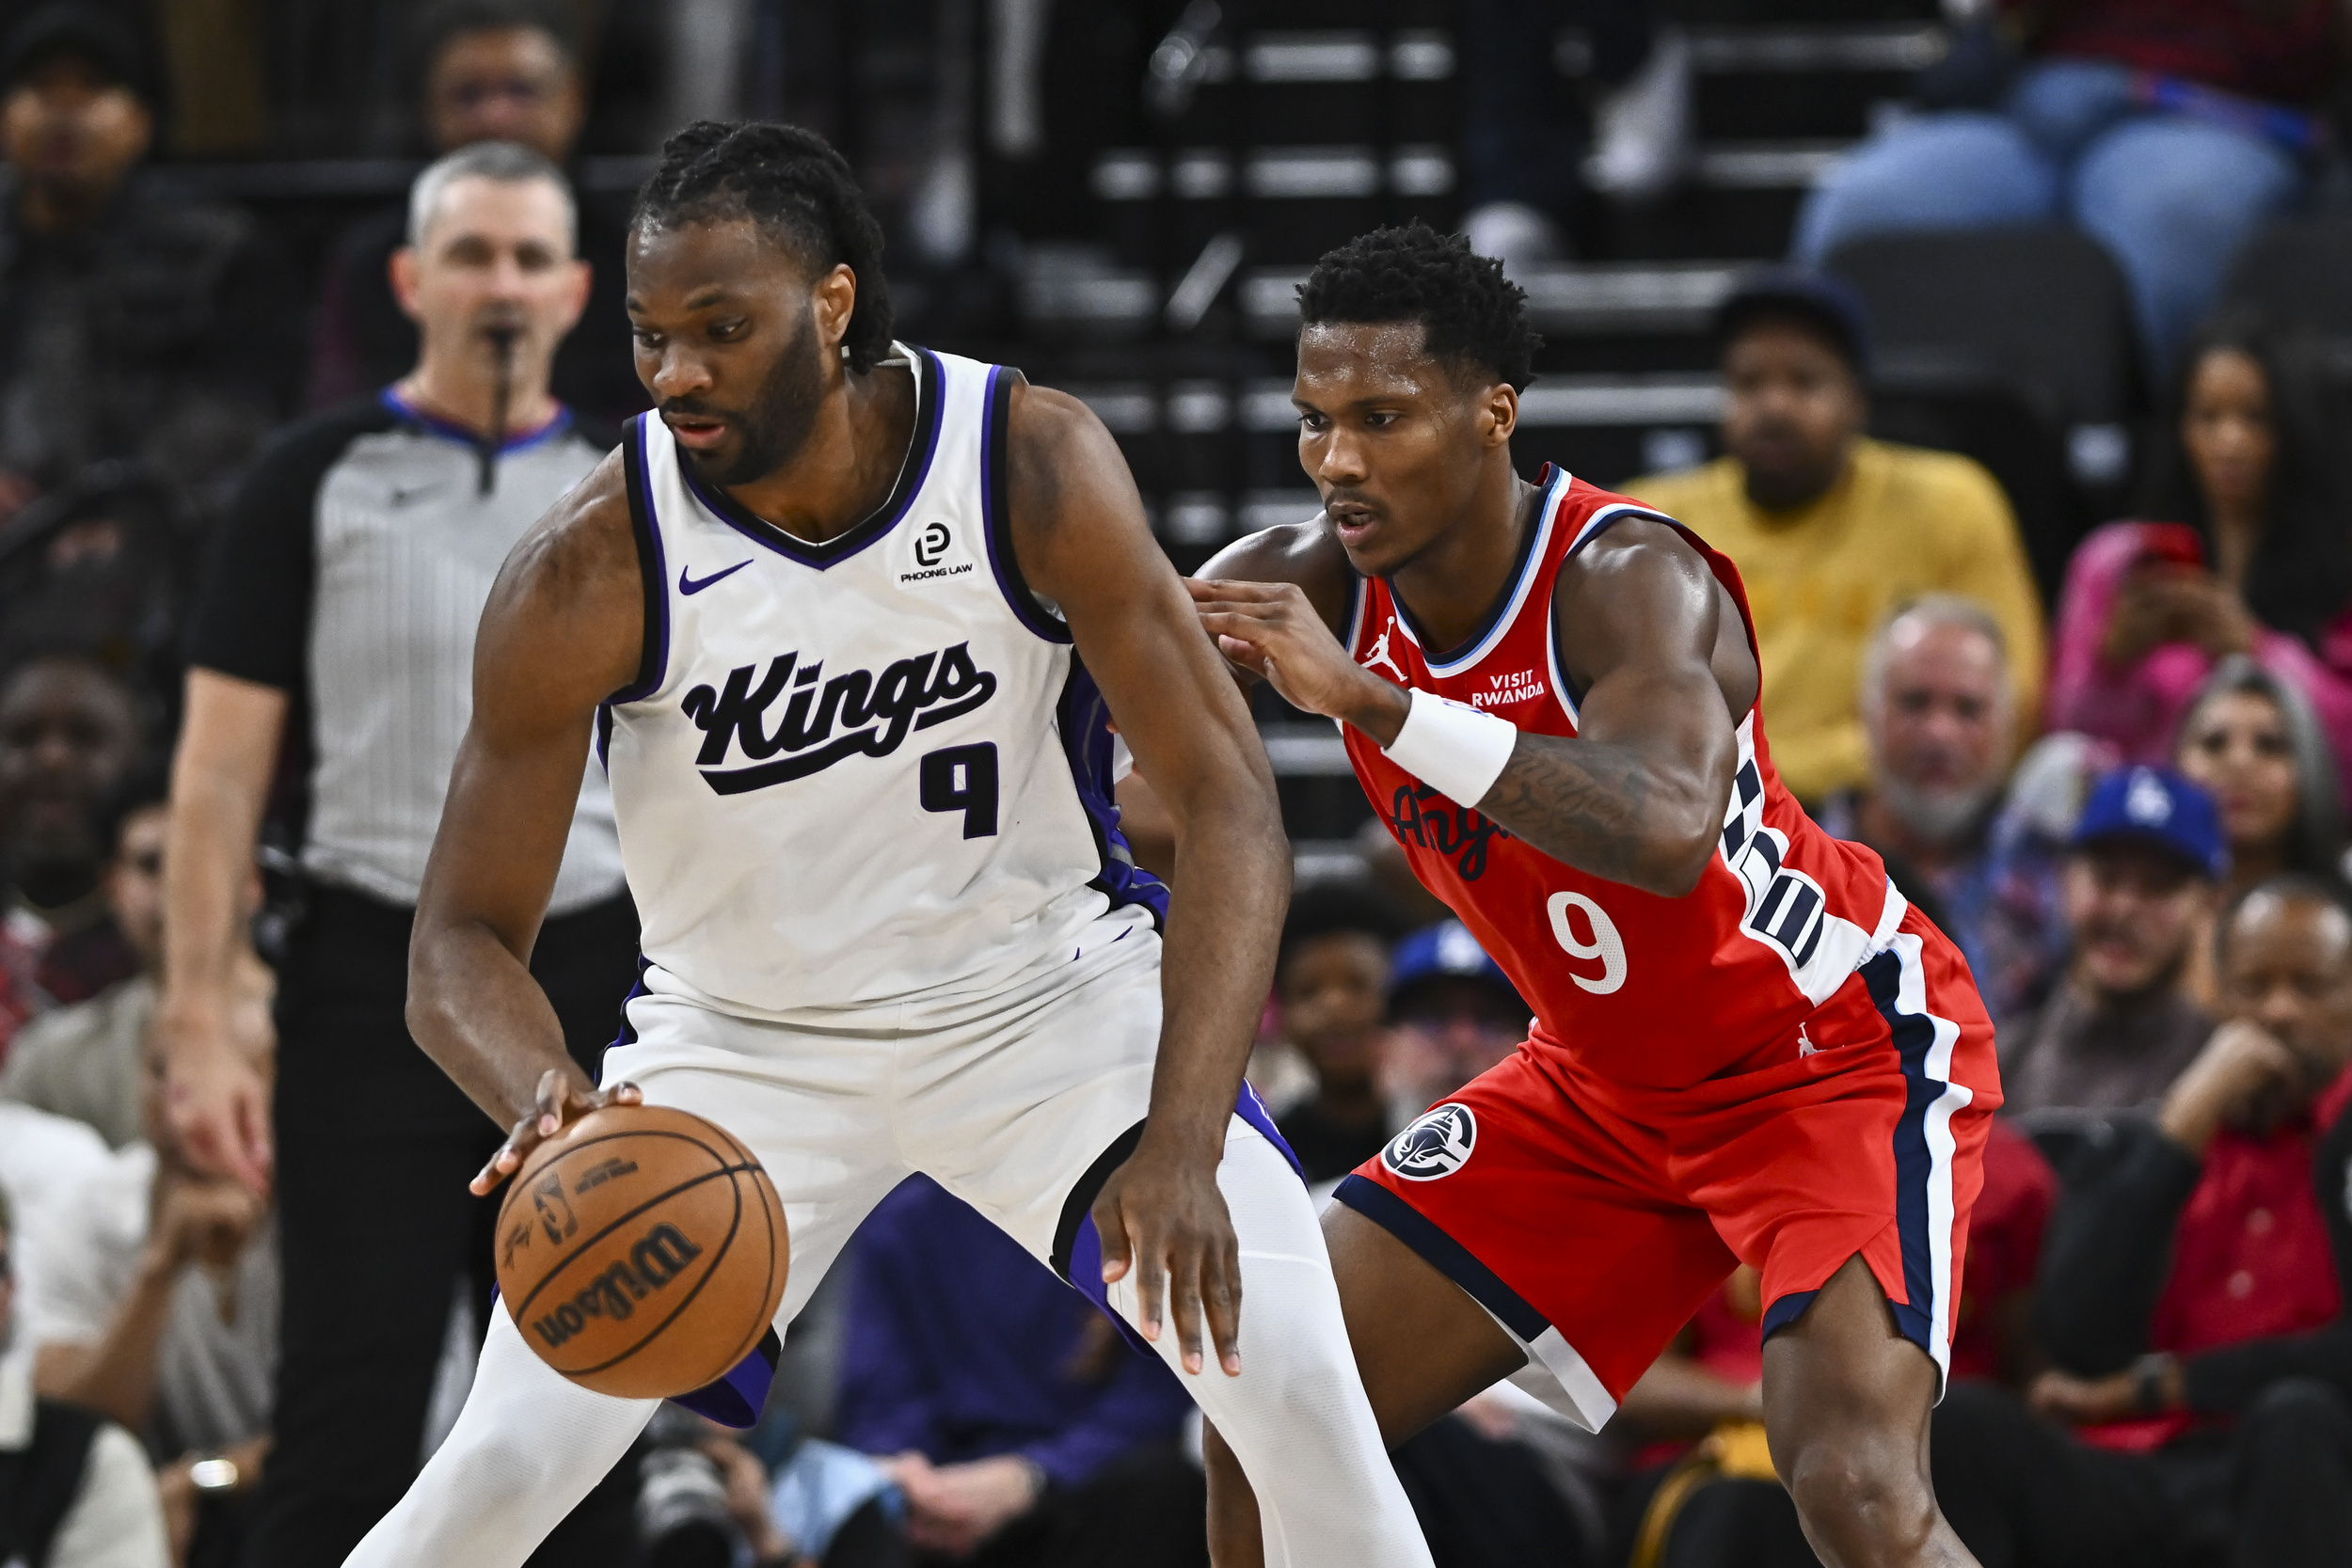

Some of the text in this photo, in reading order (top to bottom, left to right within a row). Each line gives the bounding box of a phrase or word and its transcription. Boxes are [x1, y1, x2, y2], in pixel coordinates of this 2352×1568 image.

[900, 562, 973, 583] PHOONG LAW
[681, 641, 997, 795] Kings
[1471, 681, 1545, 707] RWANDA
[1489, 669, 1534, 689] VISIT
[920, 741, 999, 840] 9
[1547, 891, 1628, 994] 9
[532, 1221, 704, 1349] Wilson
